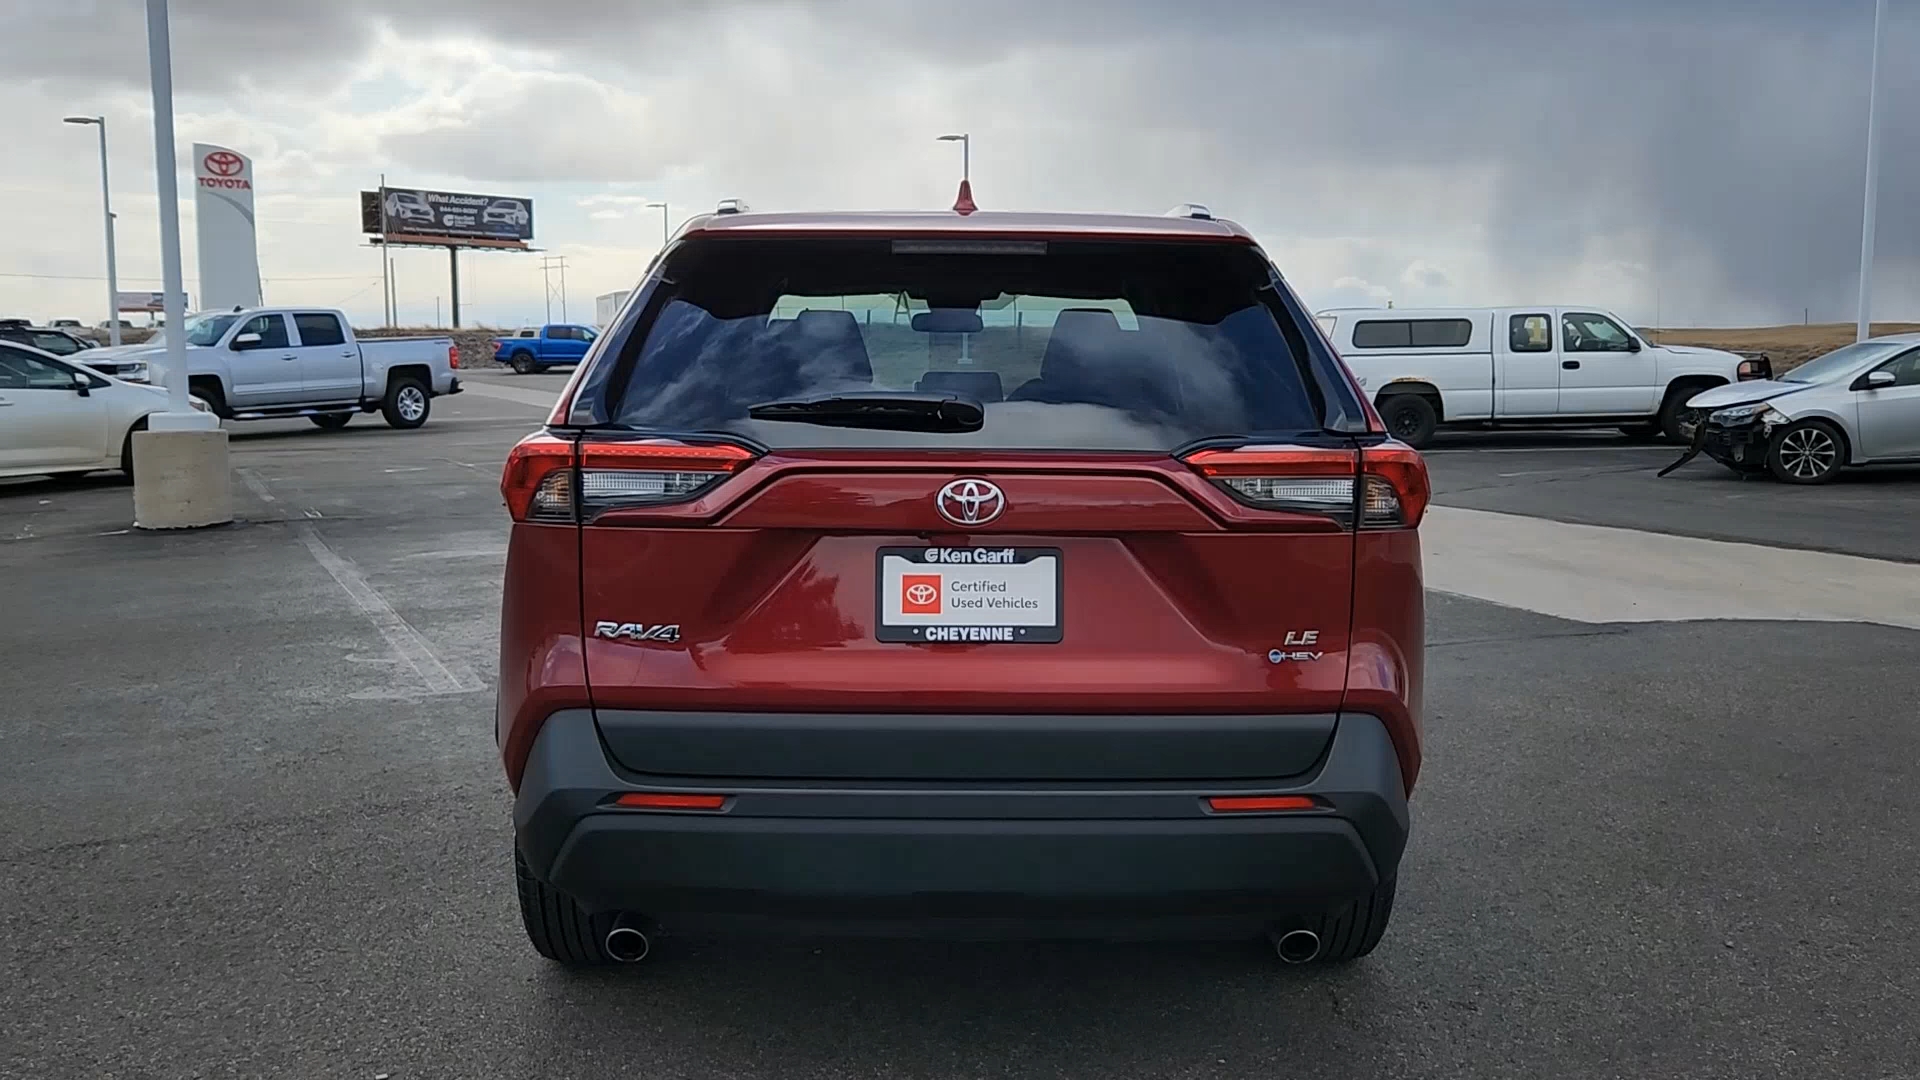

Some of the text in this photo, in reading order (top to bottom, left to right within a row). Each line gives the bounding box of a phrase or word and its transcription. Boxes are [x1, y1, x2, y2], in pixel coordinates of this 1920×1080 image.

[198, 177, 252, 189] TOYOTA
[427, 193, 489, 206] What Accident?
[940, 548, 1015, 563] Ken Garff
[951, 581, 1007, 593] Certified
[951, 597, 1038, 609] Used Vehicles
[594, 621, 681, 643] RAV4
[925, 627, 1014, 641] CHEYENNE
[1284, 630, 1319, 645] LE
